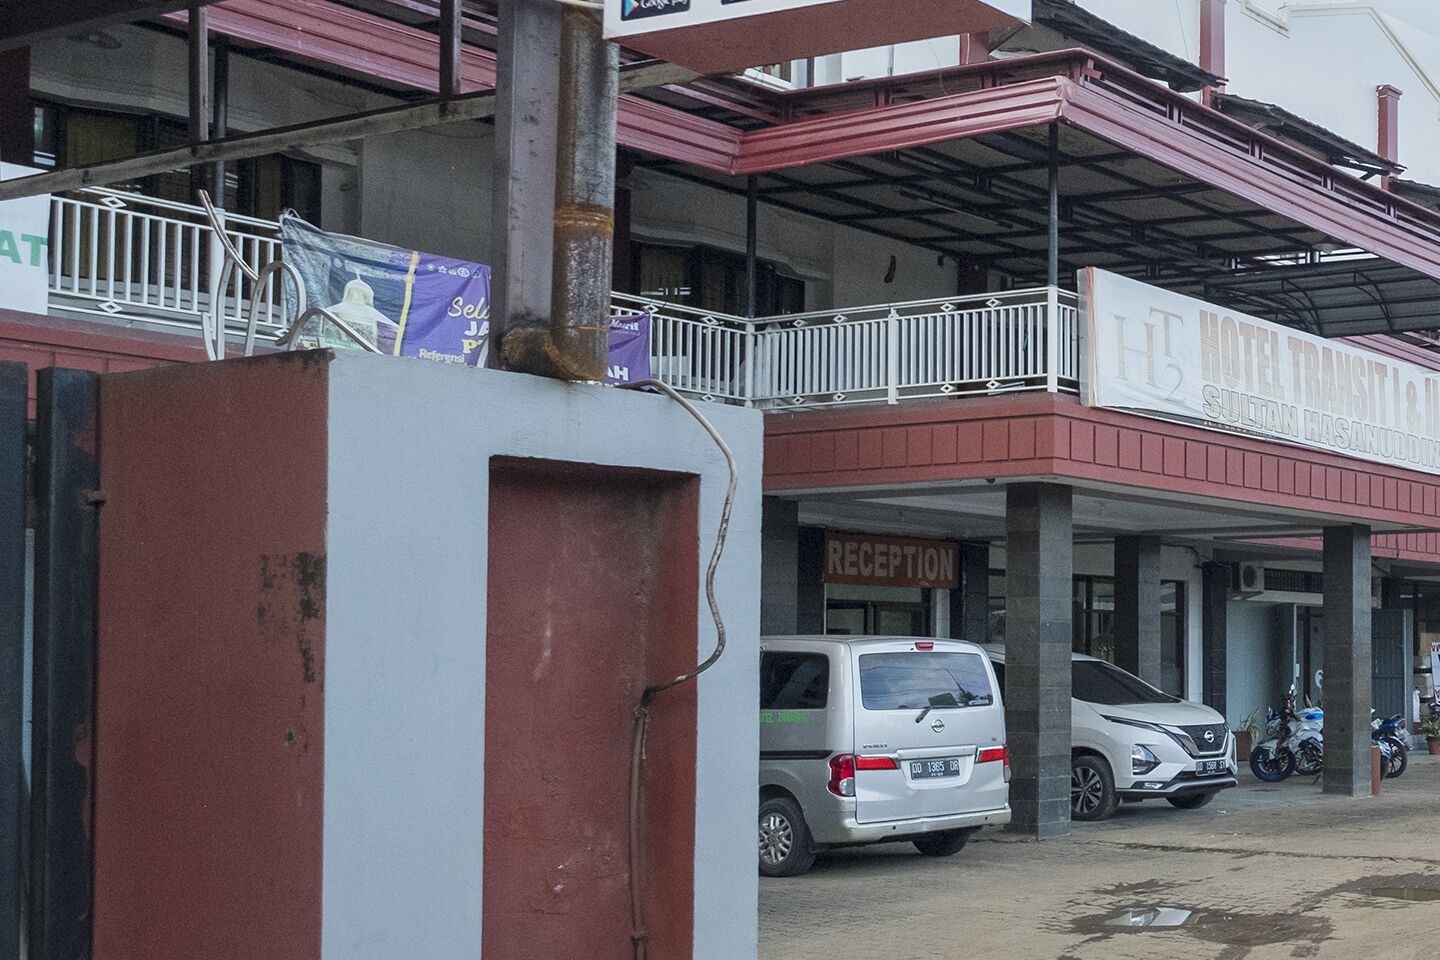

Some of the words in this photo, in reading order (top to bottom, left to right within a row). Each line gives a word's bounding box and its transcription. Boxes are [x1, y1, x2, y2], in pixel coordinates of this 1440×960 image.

[0, 230, 48, 267] AT
[419, 348, 465, 363] Referensi
[1200, 309, 1285, 400] HOTEL
[1288, 336, 1388, 425] TRANSIT
[1405, 380, 1421, 433] &
[1202, 384, 1299, 438] SULTAN
[827, 540, 955, 583] RECEPTION
